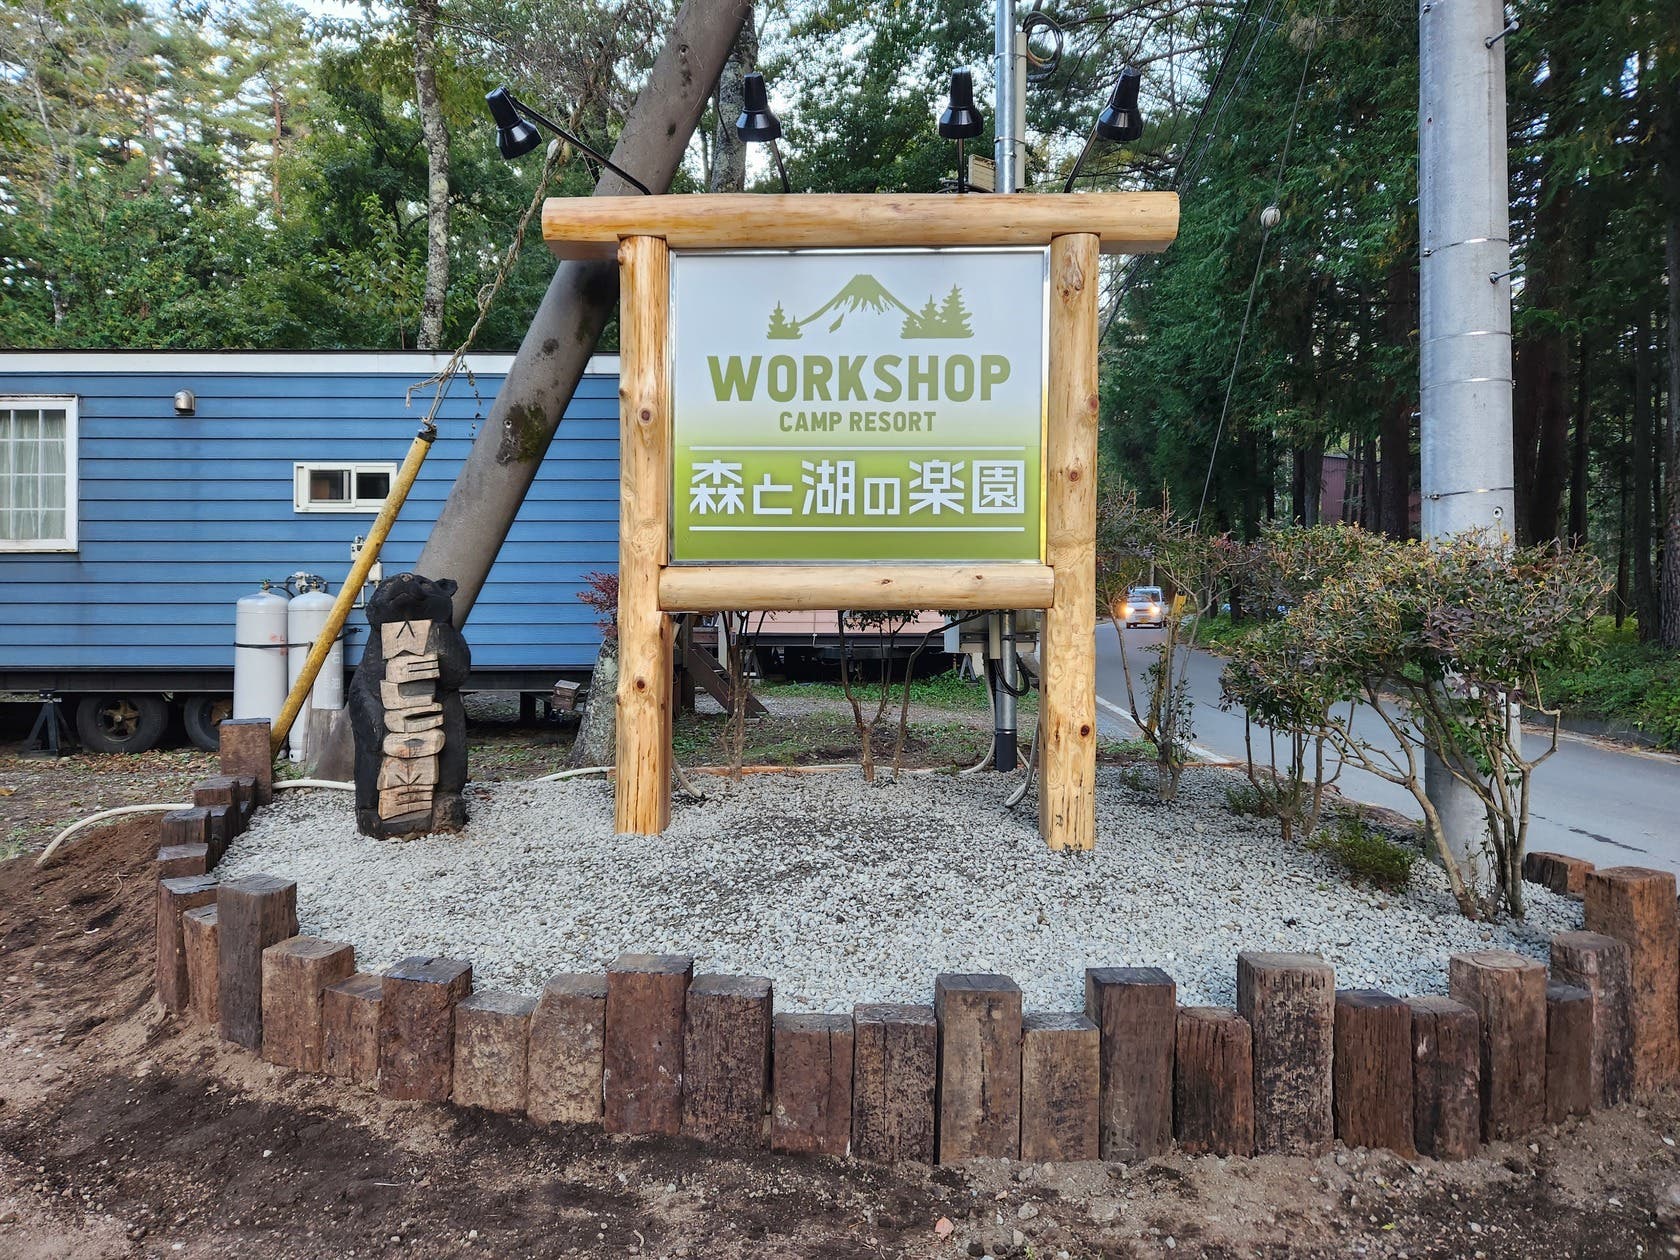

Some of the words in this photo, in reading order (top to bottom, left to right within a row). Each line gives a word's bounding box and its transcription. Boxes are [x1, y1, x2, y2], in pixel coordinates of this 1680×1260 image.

[707, 354, 1011, 402] WORKSHOP
[779, 411, 842, 432] CAMP
[849, 411, 937, 432] RESORT
[689, 459, 1025, 515] 森と湖の楽園
